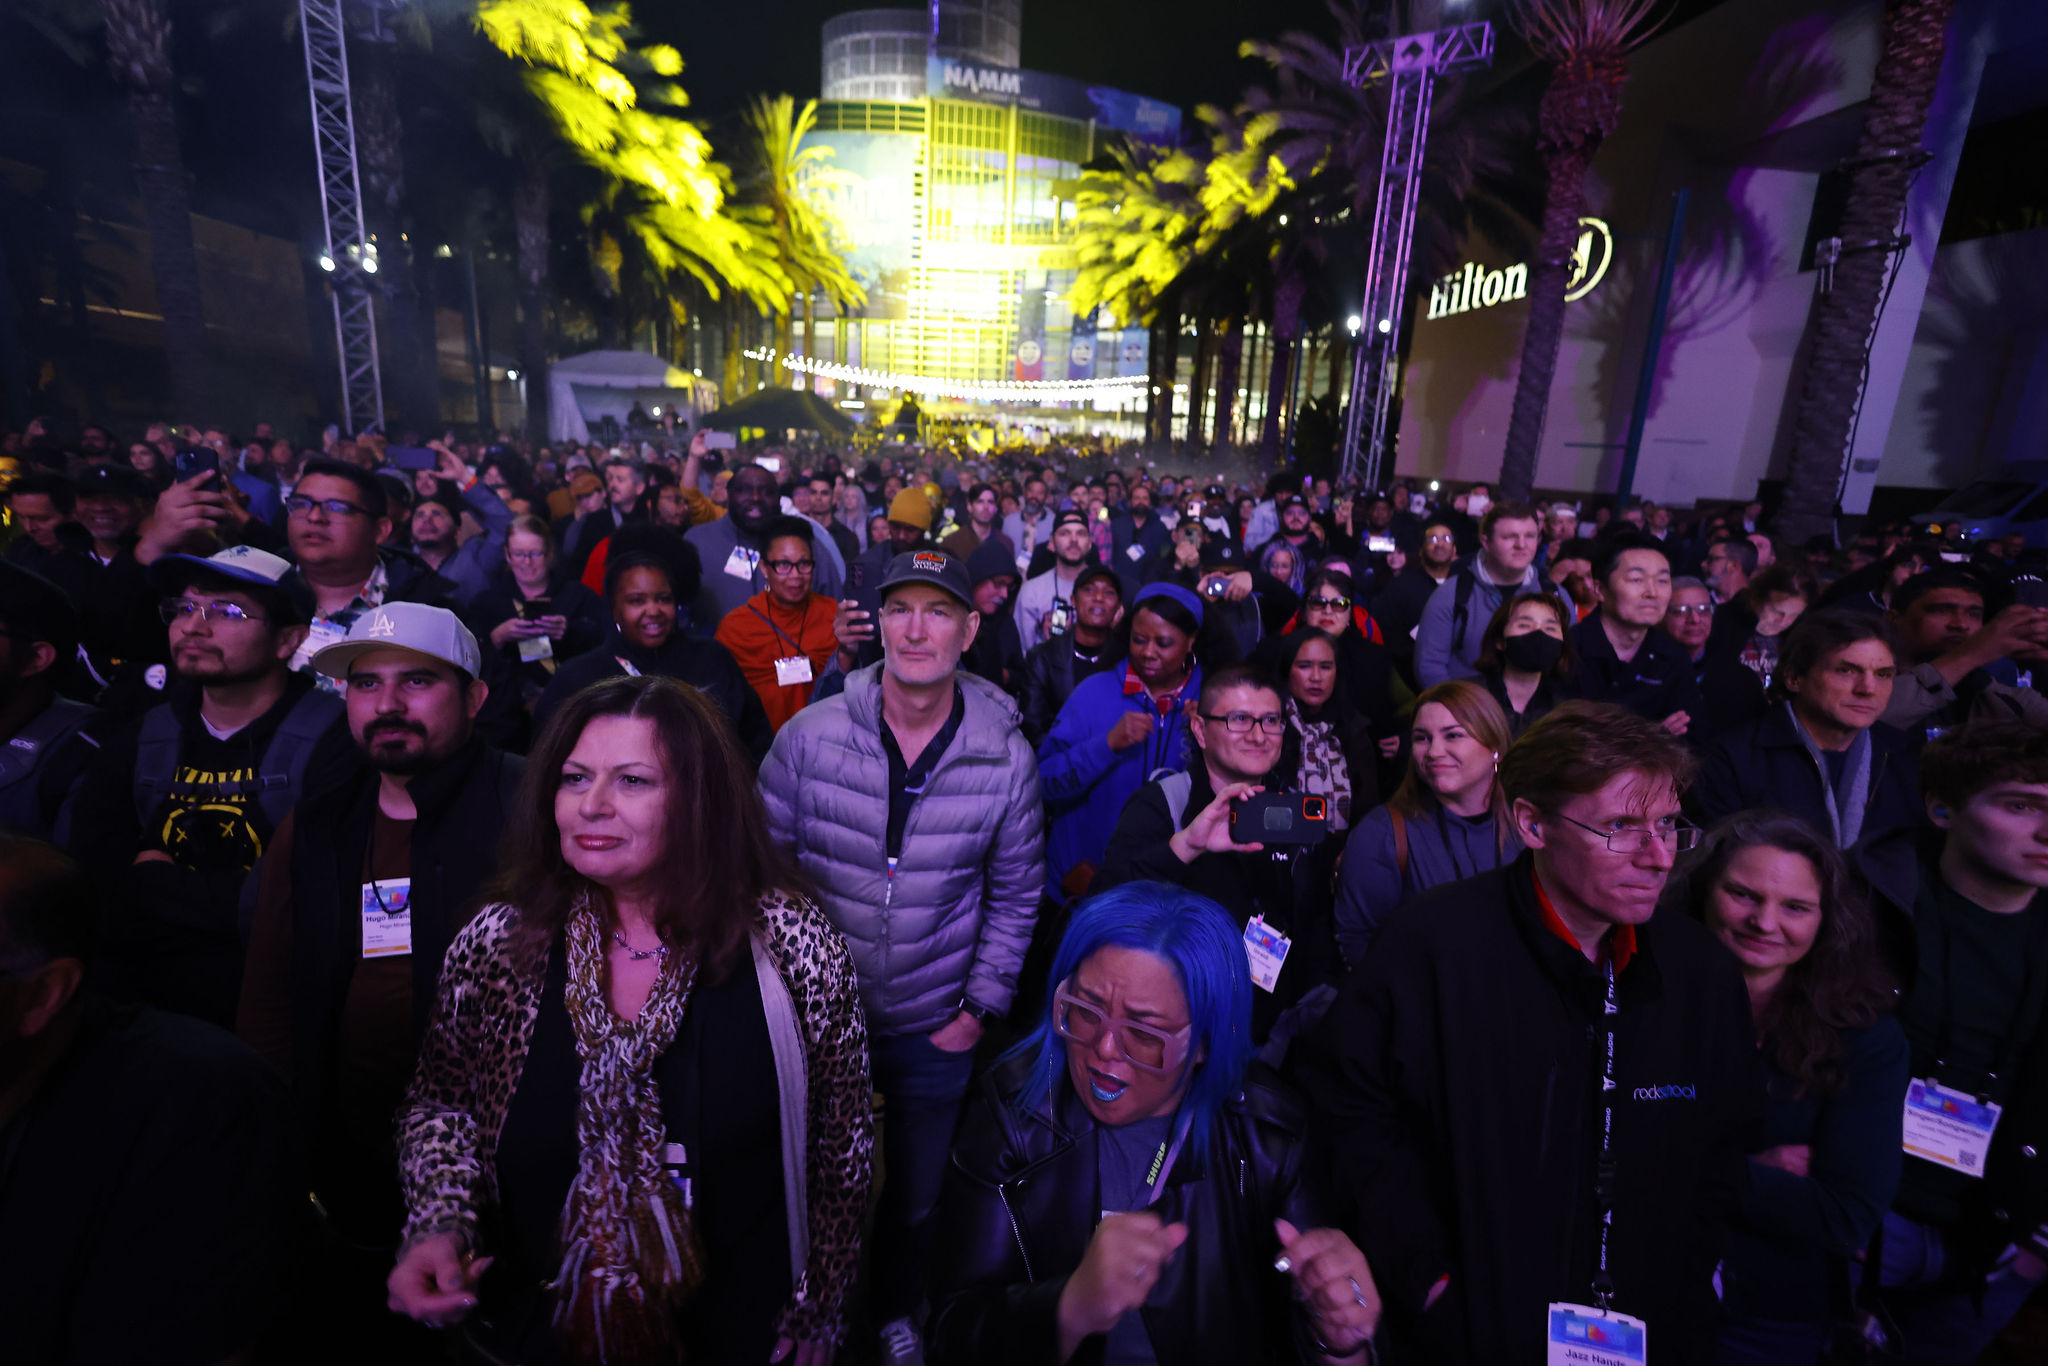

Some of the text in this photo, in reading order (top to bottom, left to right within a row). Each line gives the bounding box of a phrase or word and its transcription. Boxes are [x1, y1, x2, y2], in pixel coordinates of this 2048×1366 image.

[943, 64, 1020, 94] NAMM
[1426, 261, 1528, 320] Hilton
[368, 608, 395, 637] LA
[1565, 1348, 1589, 1361] Jazz
